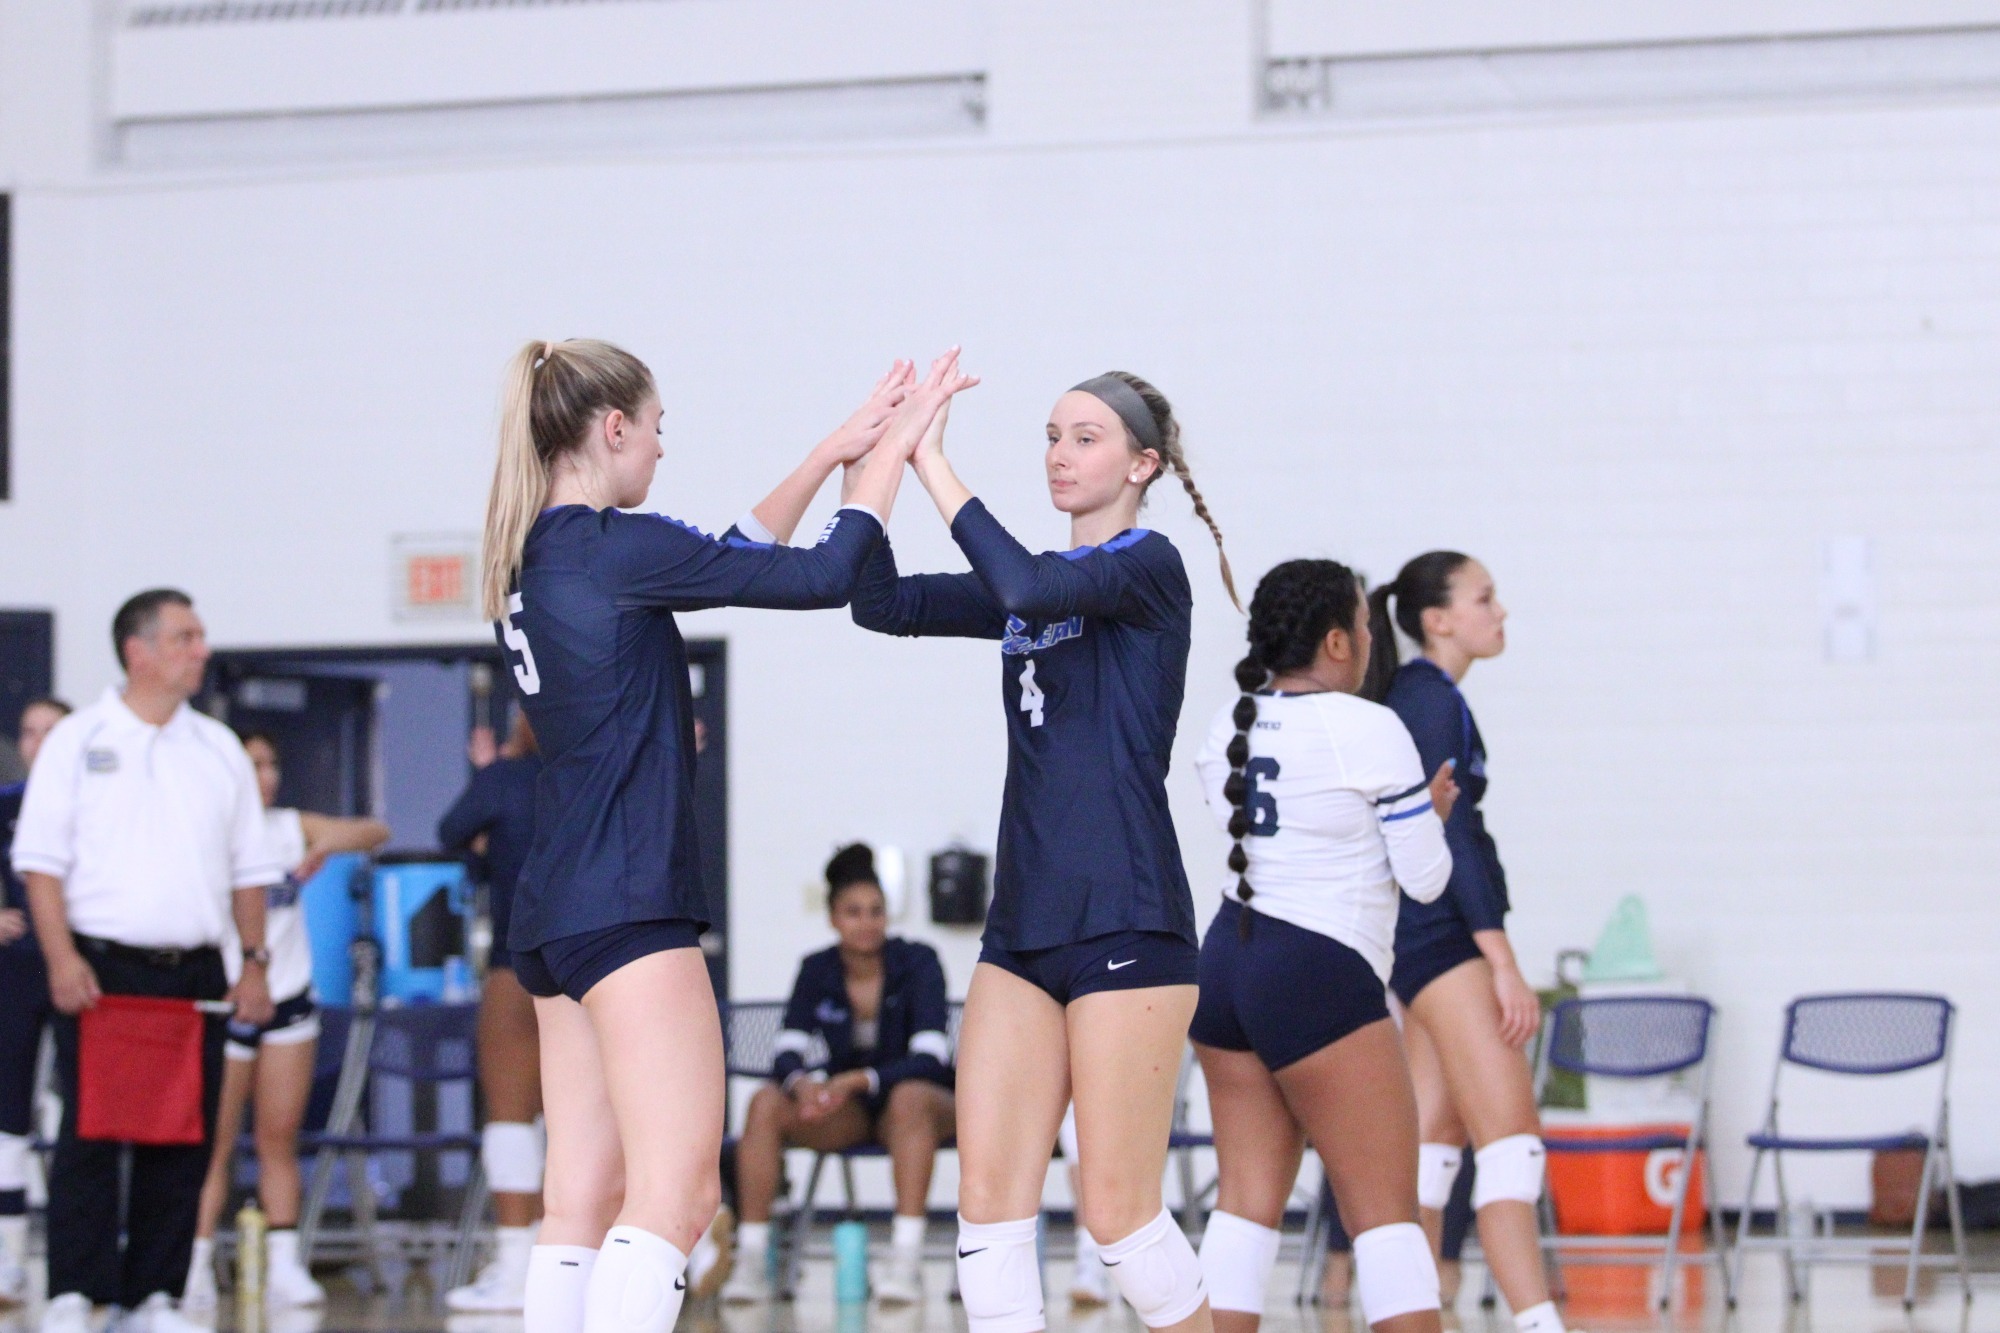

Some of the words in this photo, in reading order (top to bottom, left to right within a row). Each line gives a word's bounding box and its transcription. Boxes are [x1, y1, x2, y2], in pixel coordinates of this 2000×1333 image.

[501, 592, 541, 696] 5
[1018, 651, 1045, 728] 4
[1246, 757, 1281, 837] 6
[1644, 1149, 1688, 1208] G
